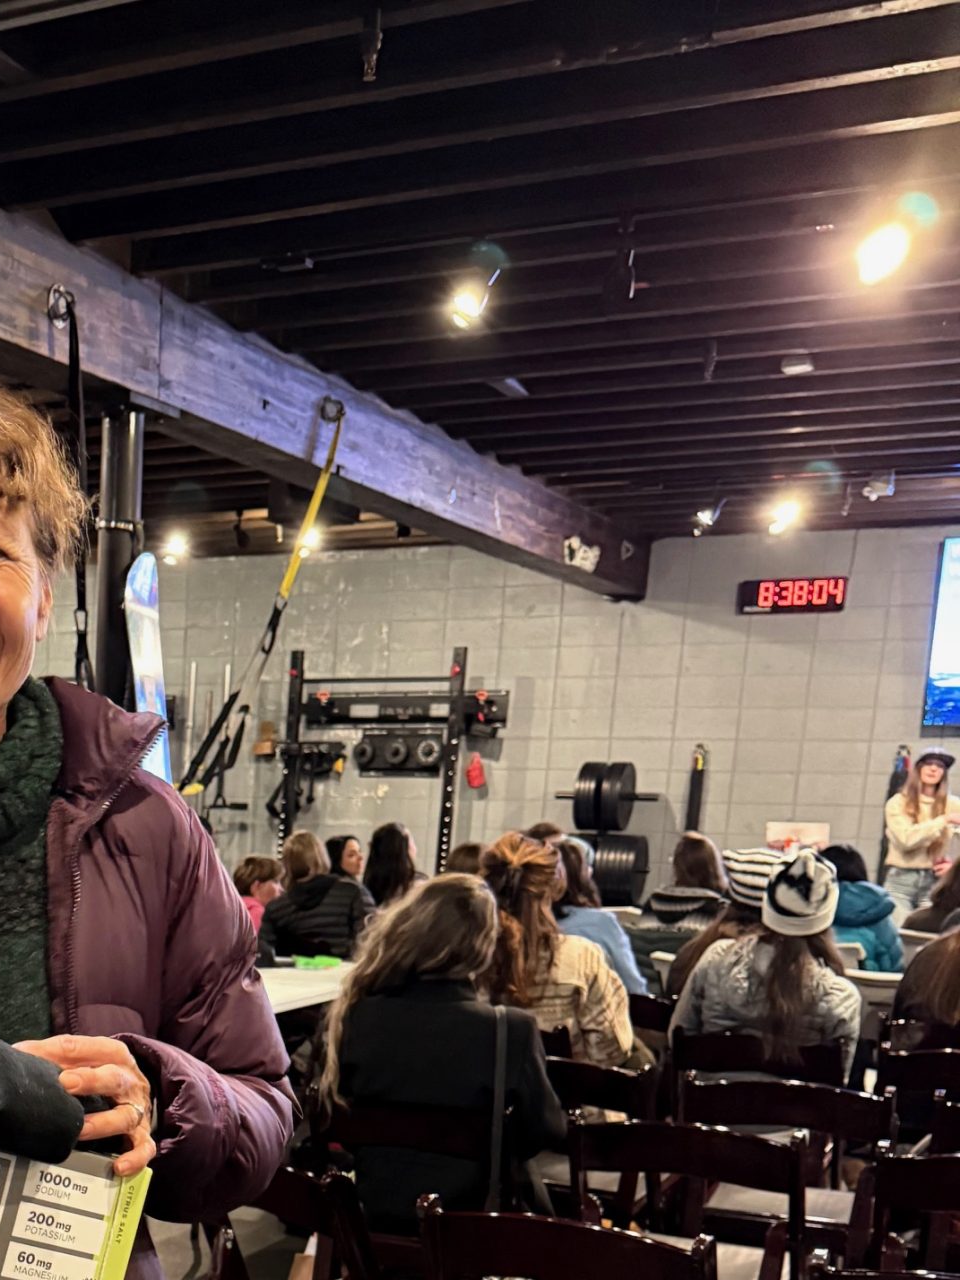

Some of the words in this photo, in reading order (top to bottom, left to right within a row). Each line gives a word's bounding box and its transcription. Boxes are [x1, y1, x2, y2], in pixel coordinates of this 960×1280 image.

[757, 578, 845, 608] 8:38:04
[34, 1184, 71, 1201] SODIUM
[39, 1170, 71, 1188] 1000
[72, 1182, 88, 1194] mg
[123, 1185, 135, 1218] CITRUS
[27, 1211, 55, 1227] 200
[55, 1220, 72, 1233] mg
[24, 1224, 76, 1244] POTASSIUM
[115, 1222, 126, 1245] SALT
[17, 1251, 36, 1265] 60
[36, 1258, 53, 1270] mg
